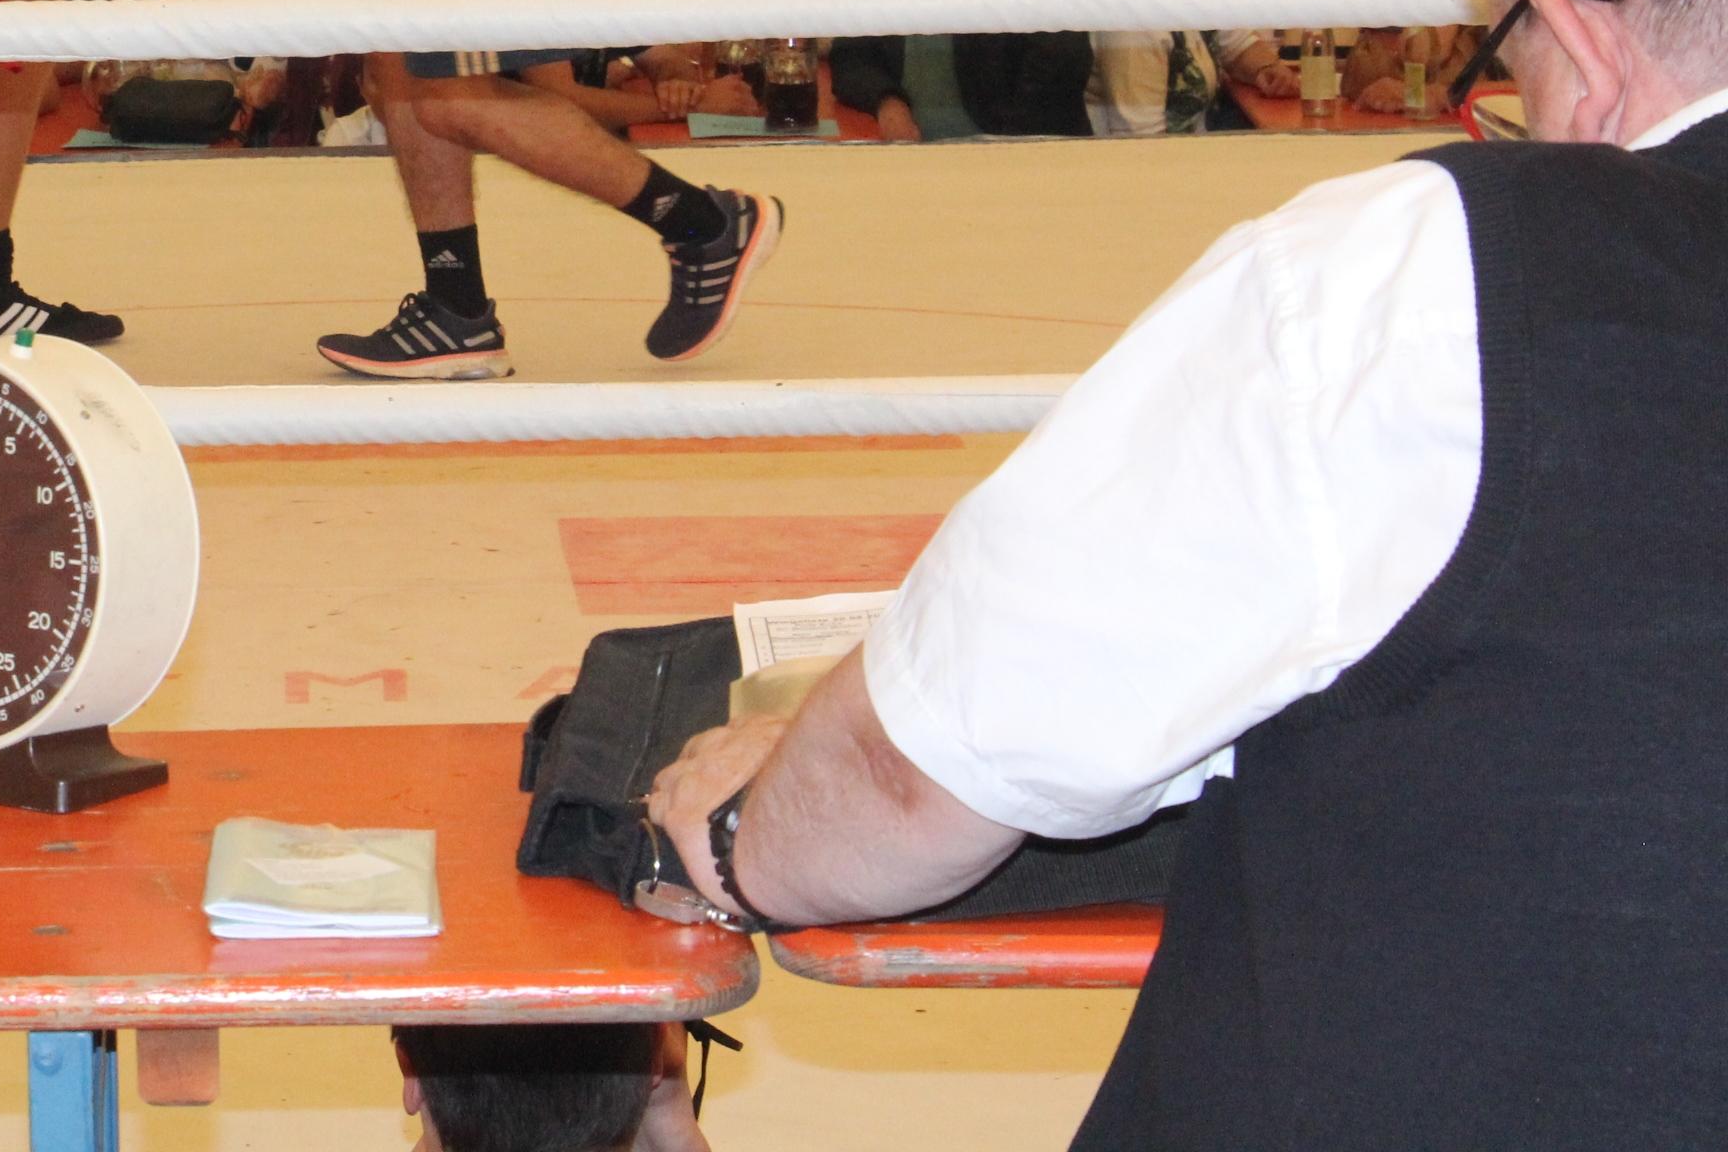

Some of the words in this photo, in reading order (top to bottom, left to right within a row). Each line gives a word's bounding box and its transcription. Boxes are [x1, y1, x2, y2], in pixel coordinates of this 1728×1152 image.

[1, 383, 11, 395] 5
[35, 409, 48, 425] 10
[4, 436, 17, 455] 5
[64, 451, 77, 466] 15
[36, 486, 53, 505] 10
[83, 501, 96, 519] 20
[49, 550, 66, 570] 15
[89, 555, 100, 575] 25
[27, 611, 52, 630] 20
[81, 607, 93, 628] 30
[61, 653, 75, 673] 35
[30, 688, 45, 705] 40
